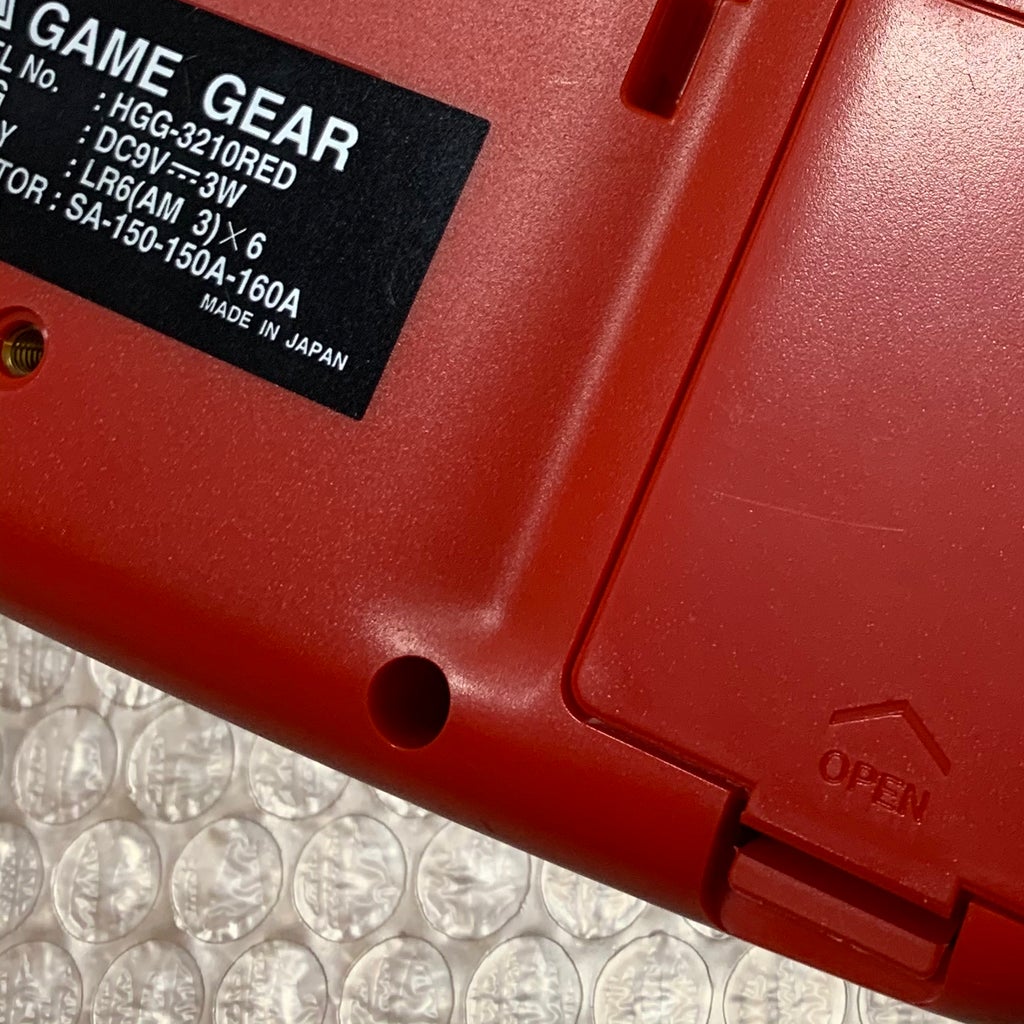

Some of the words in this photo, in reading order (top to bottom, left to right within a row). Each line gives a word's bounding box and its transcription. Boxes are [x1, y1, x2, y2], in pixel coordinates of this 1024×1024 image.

[19, 53, 59, 93] No.
[108, 92, 297, 190] HGG-3210RED
[28, 1, 184, 98] GAME
[202, 73, 359, 172] GEAR
[65, 192, 301, 319] SA-150-150A-160A
[199, 293, 254, 329] MADE
[258, 319, 281, 341] IN
[285, 332, 349, 371] JAPAN
[819, 749, 931, 824] OPEN
